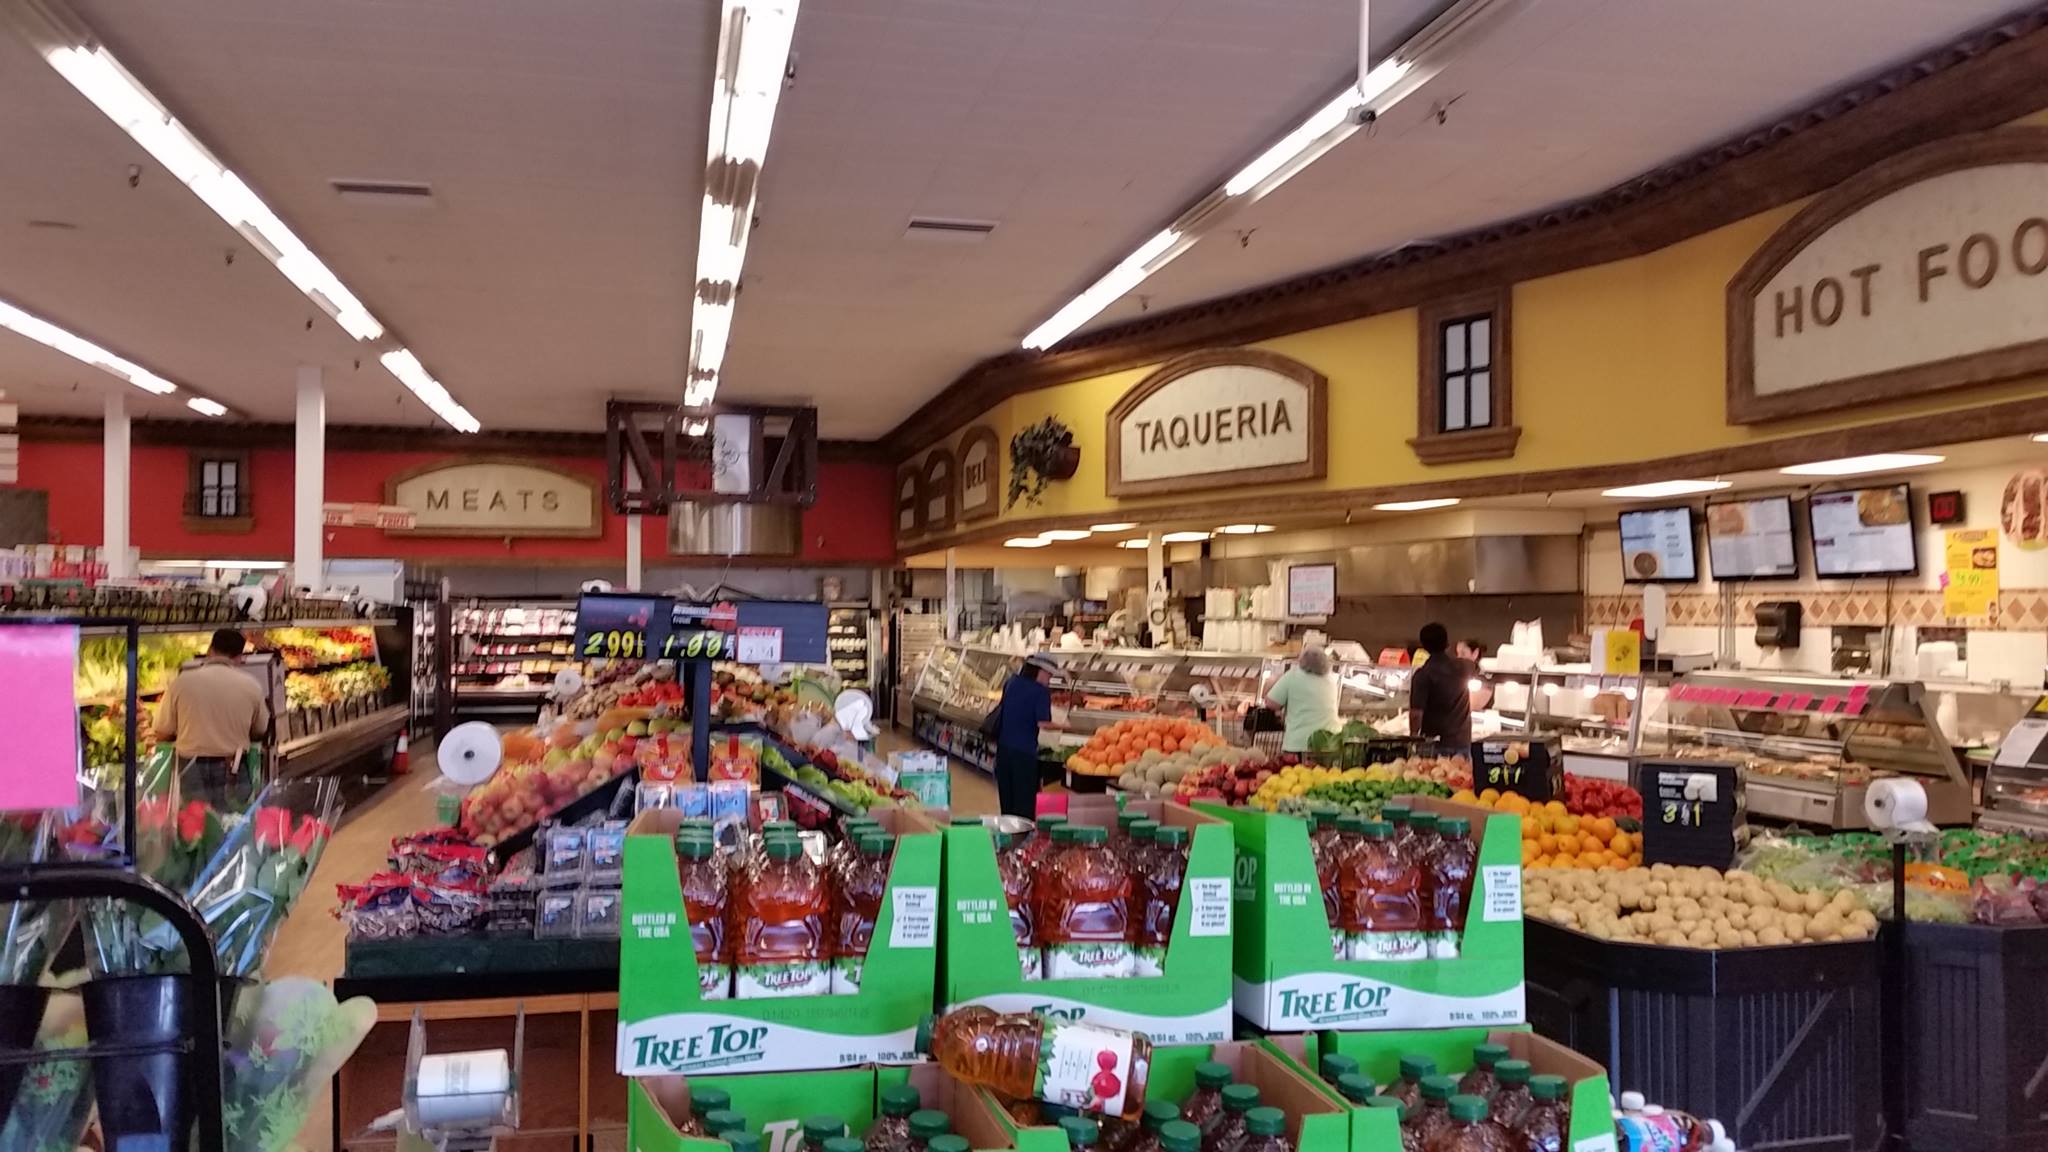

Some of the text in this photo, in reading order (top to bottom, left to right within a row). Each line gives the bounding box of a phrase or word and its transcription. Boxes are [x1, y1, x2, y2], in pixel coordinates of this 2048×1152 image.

[1775, 217, 2048, 338] HOT FOO
[1135, 398, 1292, 454] TAQUERIA
[966, 459, 986, 490] DELI
[426, 489, 560, 512] MEATS
[1234, 847, 1258, 887] OP
[631, 912, 666, 926] BOTTLED
[638, 926, 652, 938] THE
[764, 970, 812, 986] TREE TOP
[1279, 988, 1336, 1018] TREE
[1341, 982, 1391, 1011] TOP
[631, 1034, 702, 1069] TREE
[707, 1024, 769, 1058] TOP
